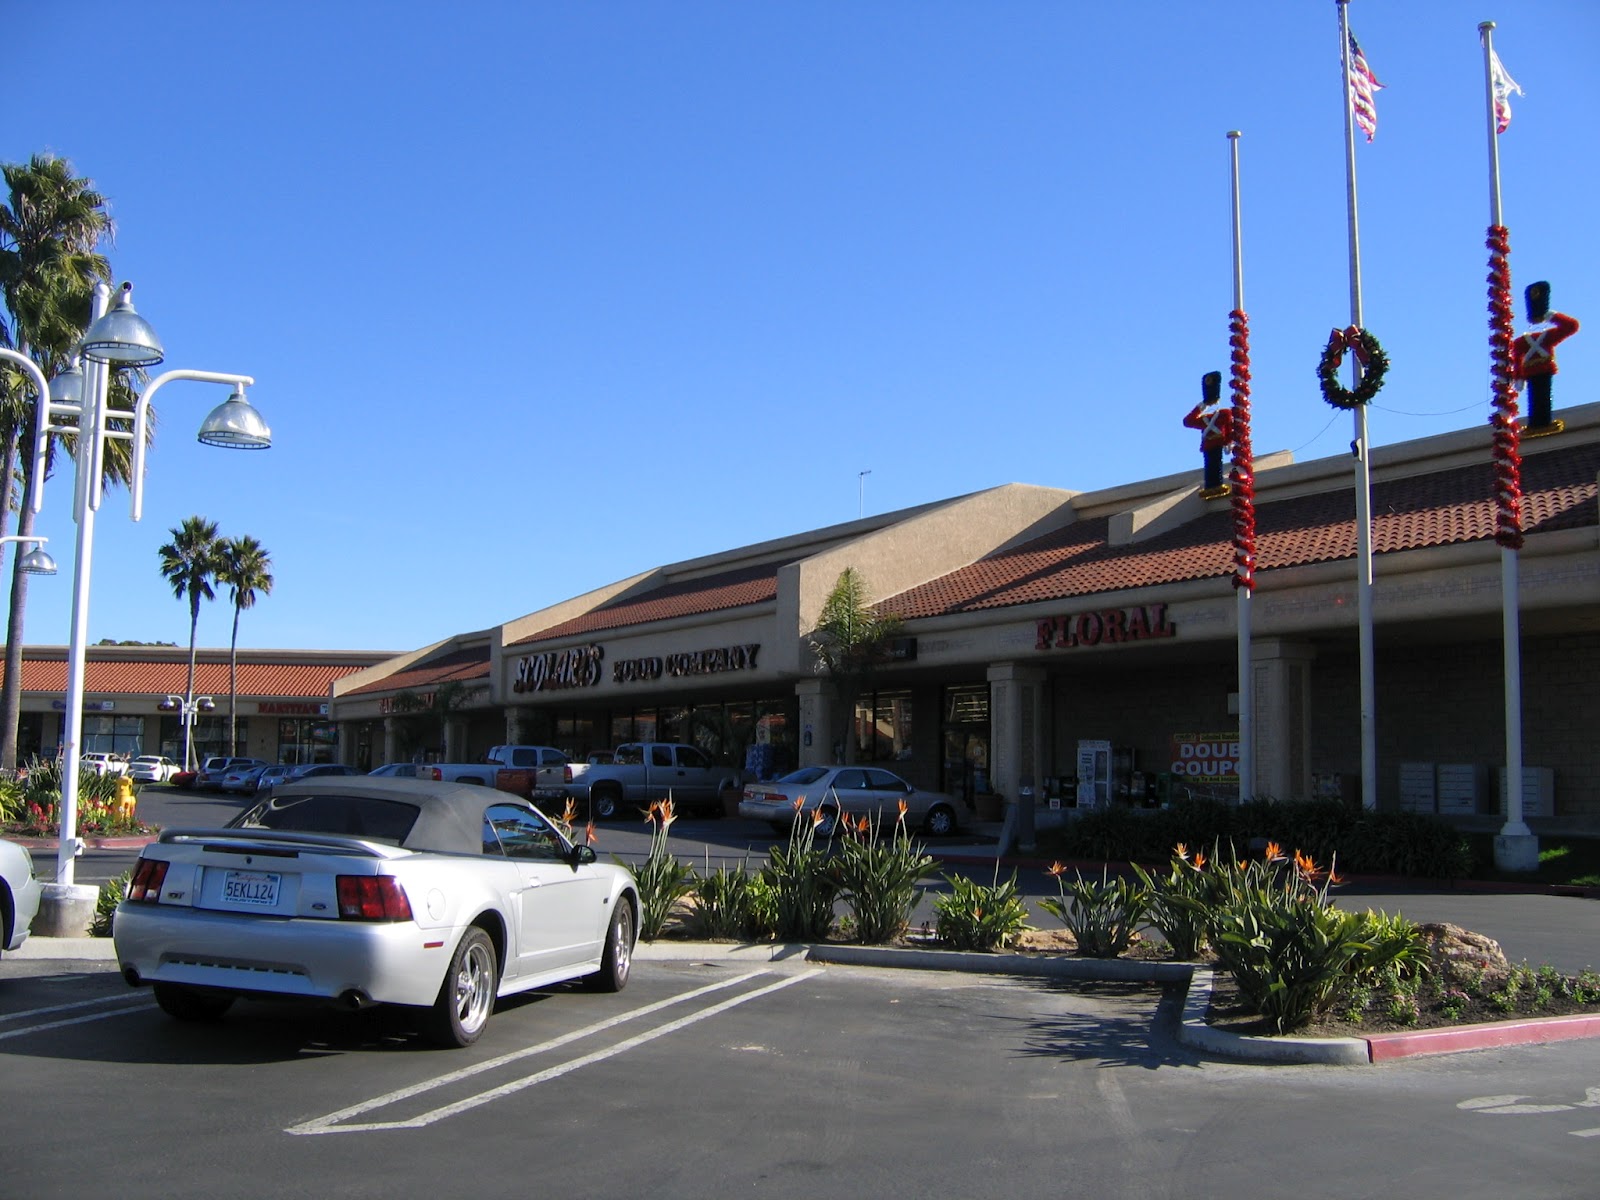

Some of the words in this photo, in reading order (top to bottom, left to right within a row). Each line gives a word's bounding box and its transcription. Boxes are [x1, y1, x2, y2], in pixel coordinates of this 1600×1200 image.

[1035, 603, 1176, 650] FLORAL
[613, 657, 663, 683] FOOD
[665, 644, 761, 677] COMPANY
[226, 882, 274, 900] 5EKL124
